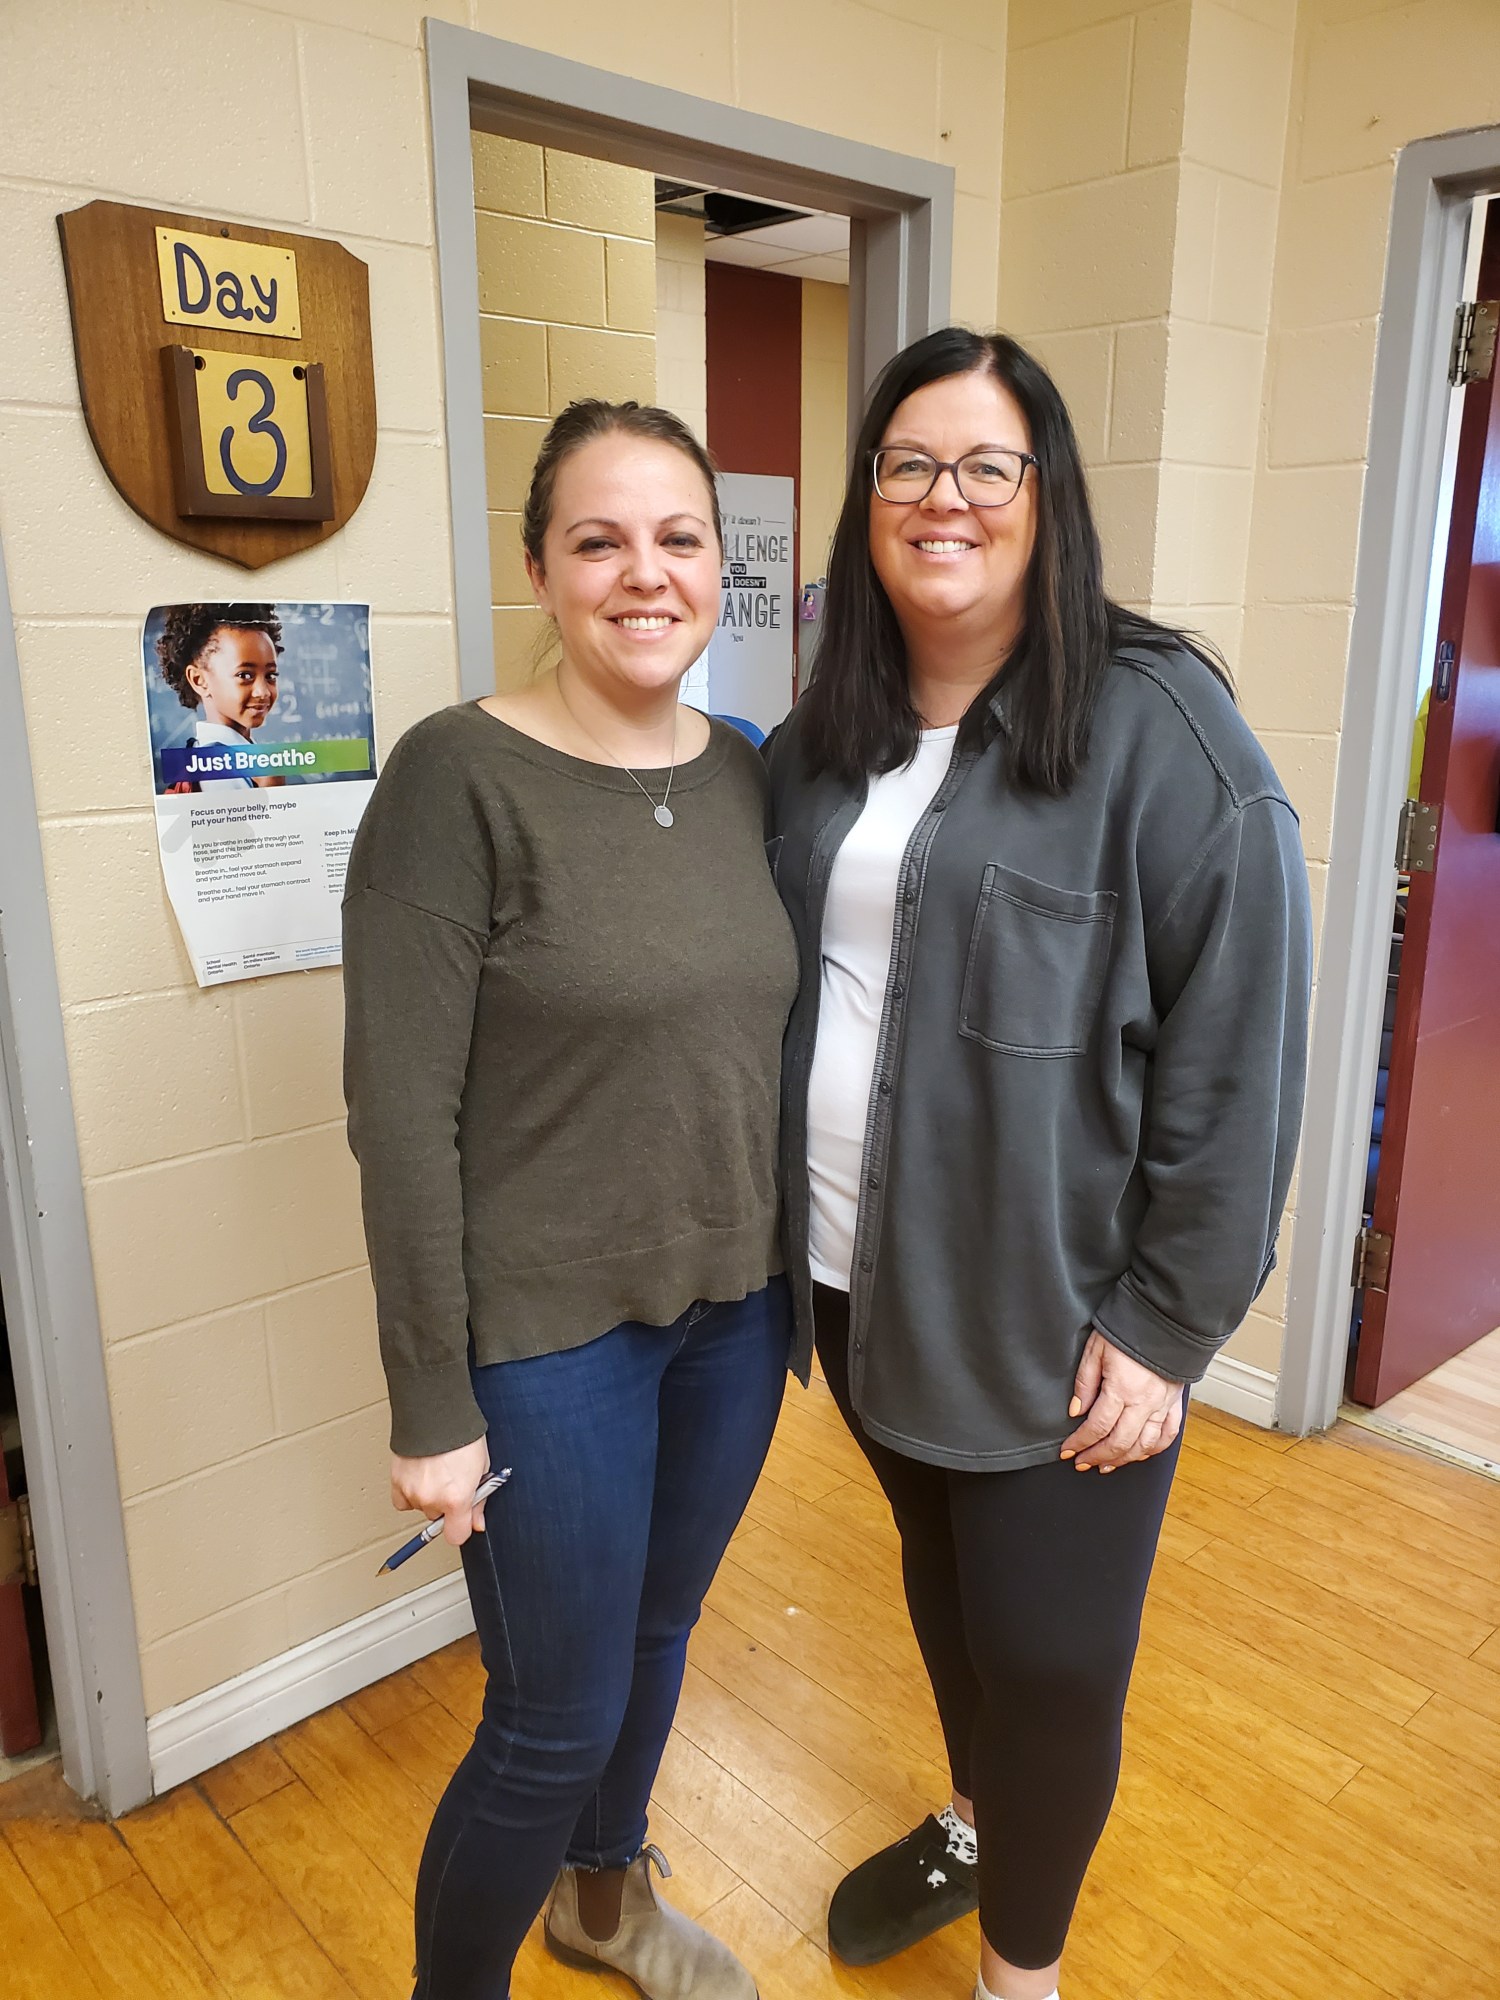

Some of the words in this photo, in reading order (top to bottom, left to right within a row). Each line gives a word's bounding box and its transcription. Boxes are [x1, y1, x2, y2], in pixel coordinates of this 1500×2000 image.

[173, 242, 277, 324] Day
[219, 368, 287, 497] 3
[724, 533, 788, 563] LLENGE
[730, 564, 746, 575] YOU
[733, 578, 766, 588] DOESN'T
[716, 592, 781, 629] ANGE
[185, 753, 232, 773] Just
[235, 748, 316, 770] Breathe
[190, 809, 215, 817] Focus
[227, 806, 246, 816] your
[246, 803, 268, 813] belly,
[269, 802, 297, 811] maybe
[191, 817, 206, 828] put
[207, 817, 225, 827] your
[226, 814, 247, 823] hand
[248, 813, 272, 821] there.
[243, 837, 263, 845] deeply
[264, 835, 287, 843] through
[216, 852, 243, 860] stomach.
[280, 859, 302, 867] expand
[286, 878, 311, 886] contract
[211, 895, 225, 903] your
[225, 892, 241, 900] hand
